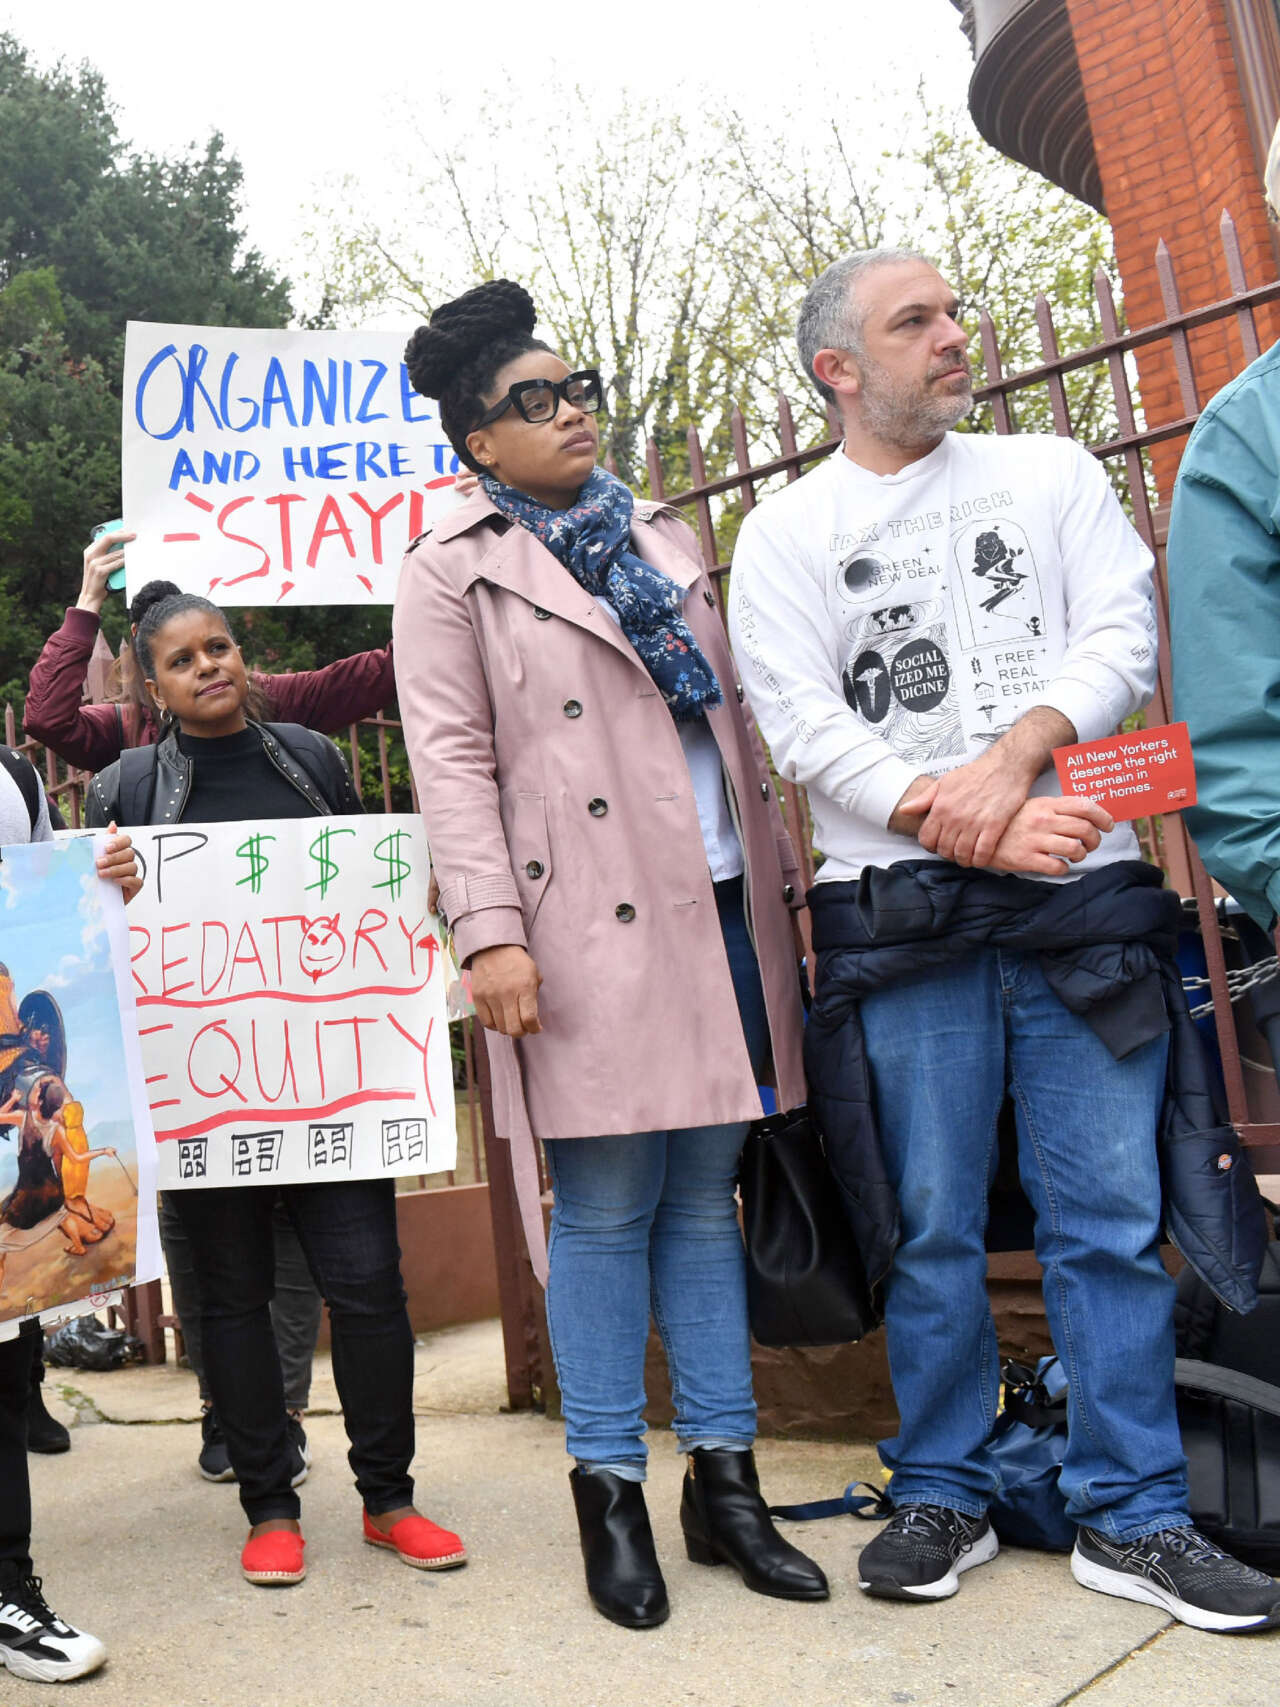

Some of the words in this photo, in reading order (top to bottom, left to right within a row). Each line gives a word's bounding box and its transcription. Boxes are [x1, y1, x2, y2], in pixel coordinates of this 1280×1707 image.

[135, 343, 441, 441] ORGANIZE
[168, 447, 261, 491] AND
[282, 441, 416, 482] HERE
[887, 511, 944, 539] THE
[949, 490, 1014, 522] RICH
[868, 571, 902, 588] NEW
[907, 565, 943, 579] DEAL
[870, 557, 922, 577] GREEN
[895, 649, 942, 672] SOCIAL
[994, 649, 1036, 666] FREE
[894, 668, 924, 687] IZED
[925, 664, 948, 680] ME
[998, 665, 1039, 681] REAL
[900, 680, 946, 701] DICINE
[1066, 755, 1084, 768] All
[1085, 749, 1117, 763] New
[1118, 738, 1169, 757] Yorkers
[1069, 762, 1123, 780] deserve
[1124, 756, 1146, 769] the
[1148, 748, 1178, 765] right
[1072, 781, 1087, 793] to
[1089, 771, 1135, 789] remain
[1137, 768, 1149, 780] in
[1109, 781, 1155, 799] homes.
[236, 832, 276, 895] $
[304, 825, 356, 901] $
[371, 828, 412, 903] $
[138, 1012, 437, 1117] EQUITY
